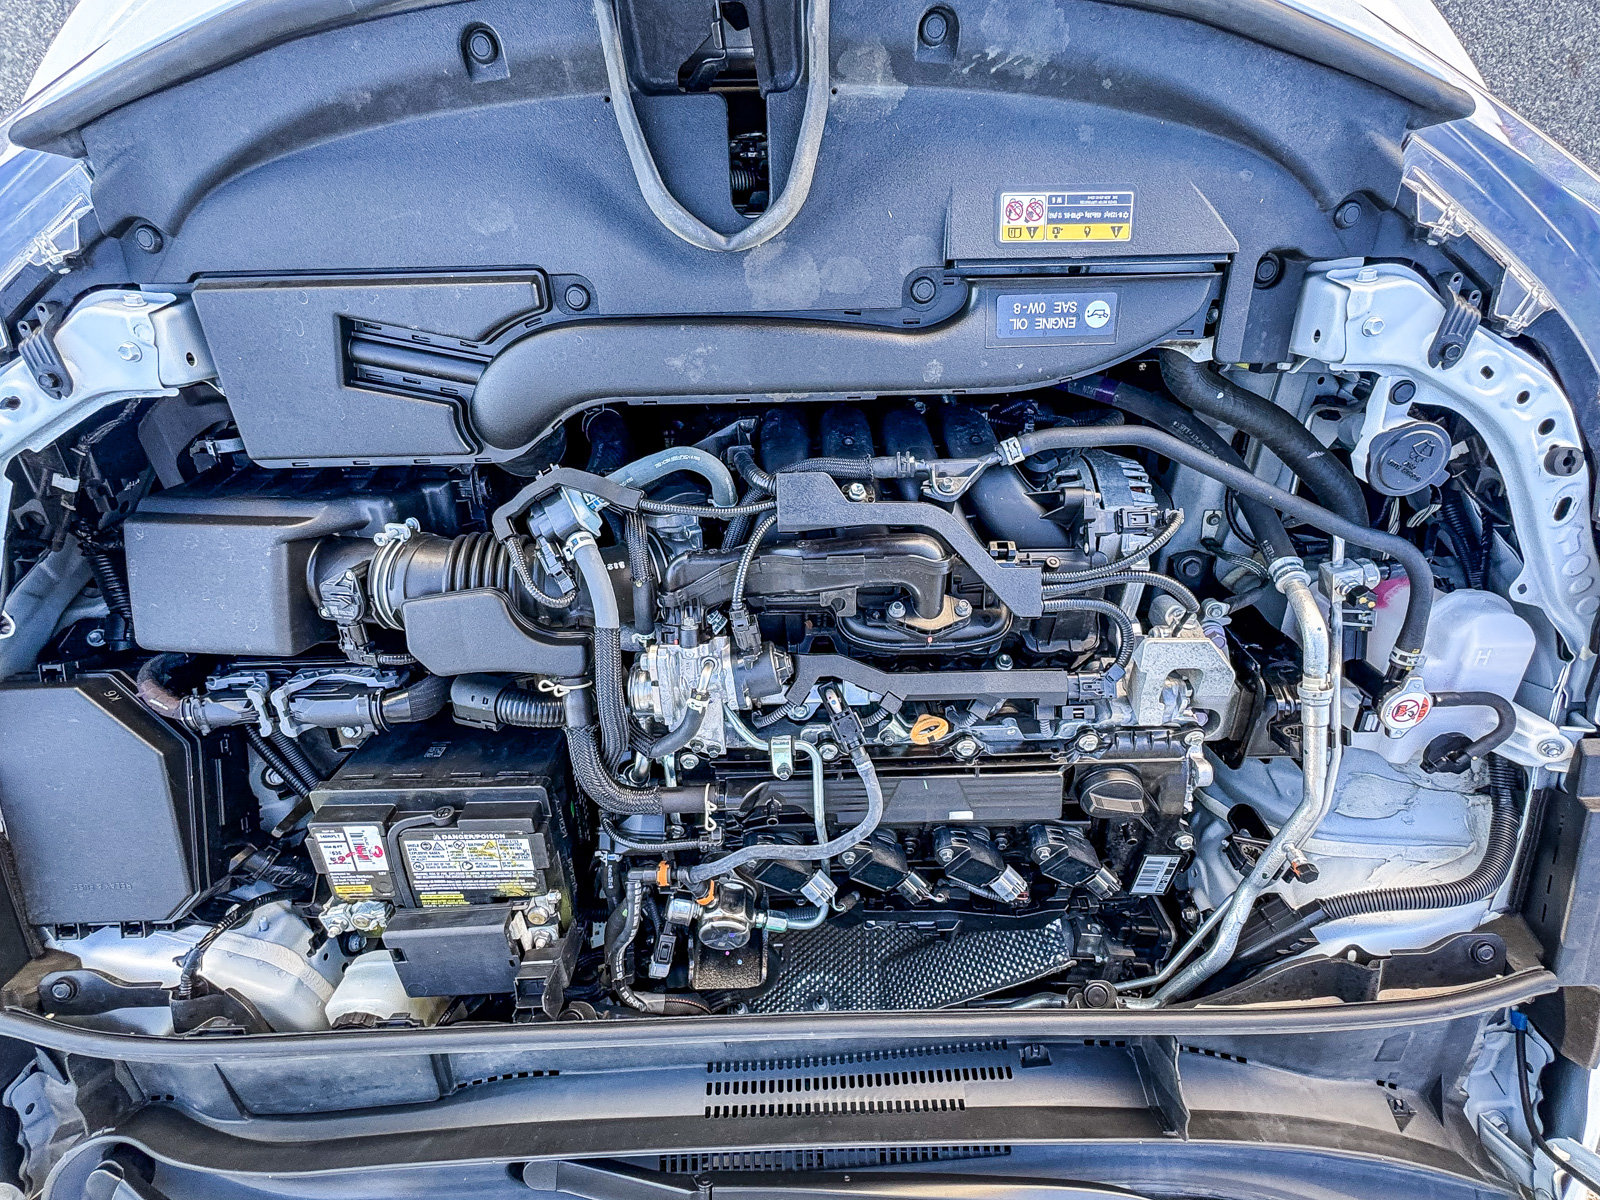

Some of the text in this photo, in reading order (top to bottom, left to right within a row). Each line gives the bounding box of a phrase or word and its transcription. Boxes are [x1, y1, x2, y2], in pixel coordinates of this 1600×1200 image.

[1013, 301, 1078, 315] SAE 0W-8
[1009, 316, 1077, 330] ENGINE OIL
